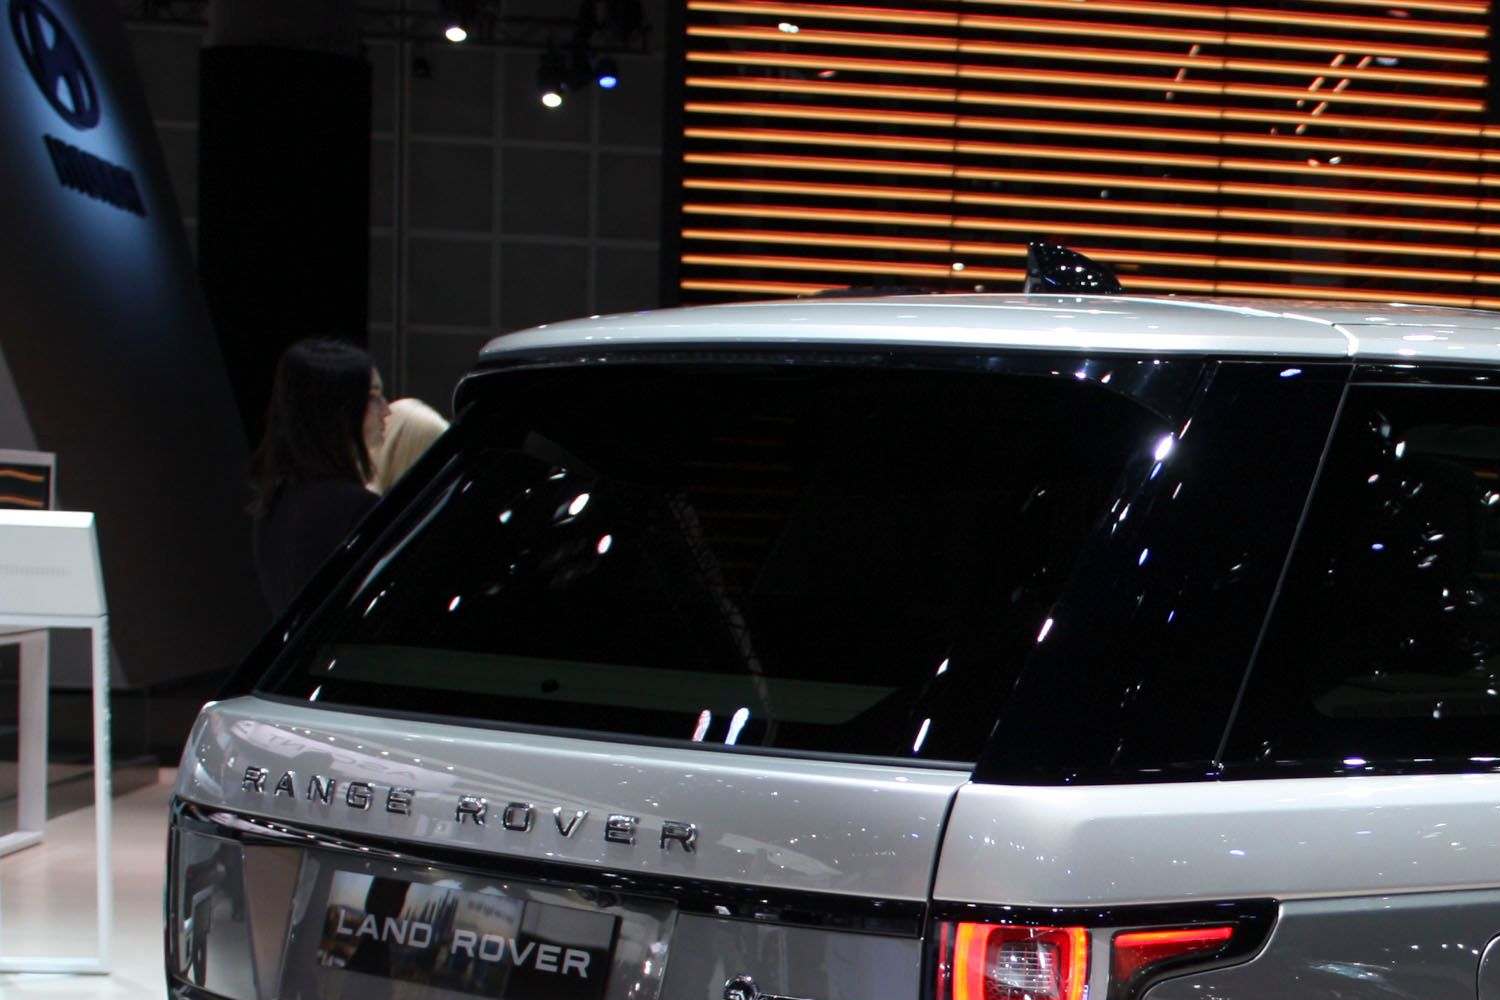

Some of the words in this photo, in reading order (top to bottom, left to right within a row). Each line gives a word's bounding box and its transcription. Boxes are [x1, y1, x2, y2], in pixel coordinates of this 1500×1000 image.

[243, 767, 415, 815] RANGE
[455, 795, 699, 853] ROVER
[336, 909, 433, 949] LAND
[451, 929, 591, 978] ROVER
